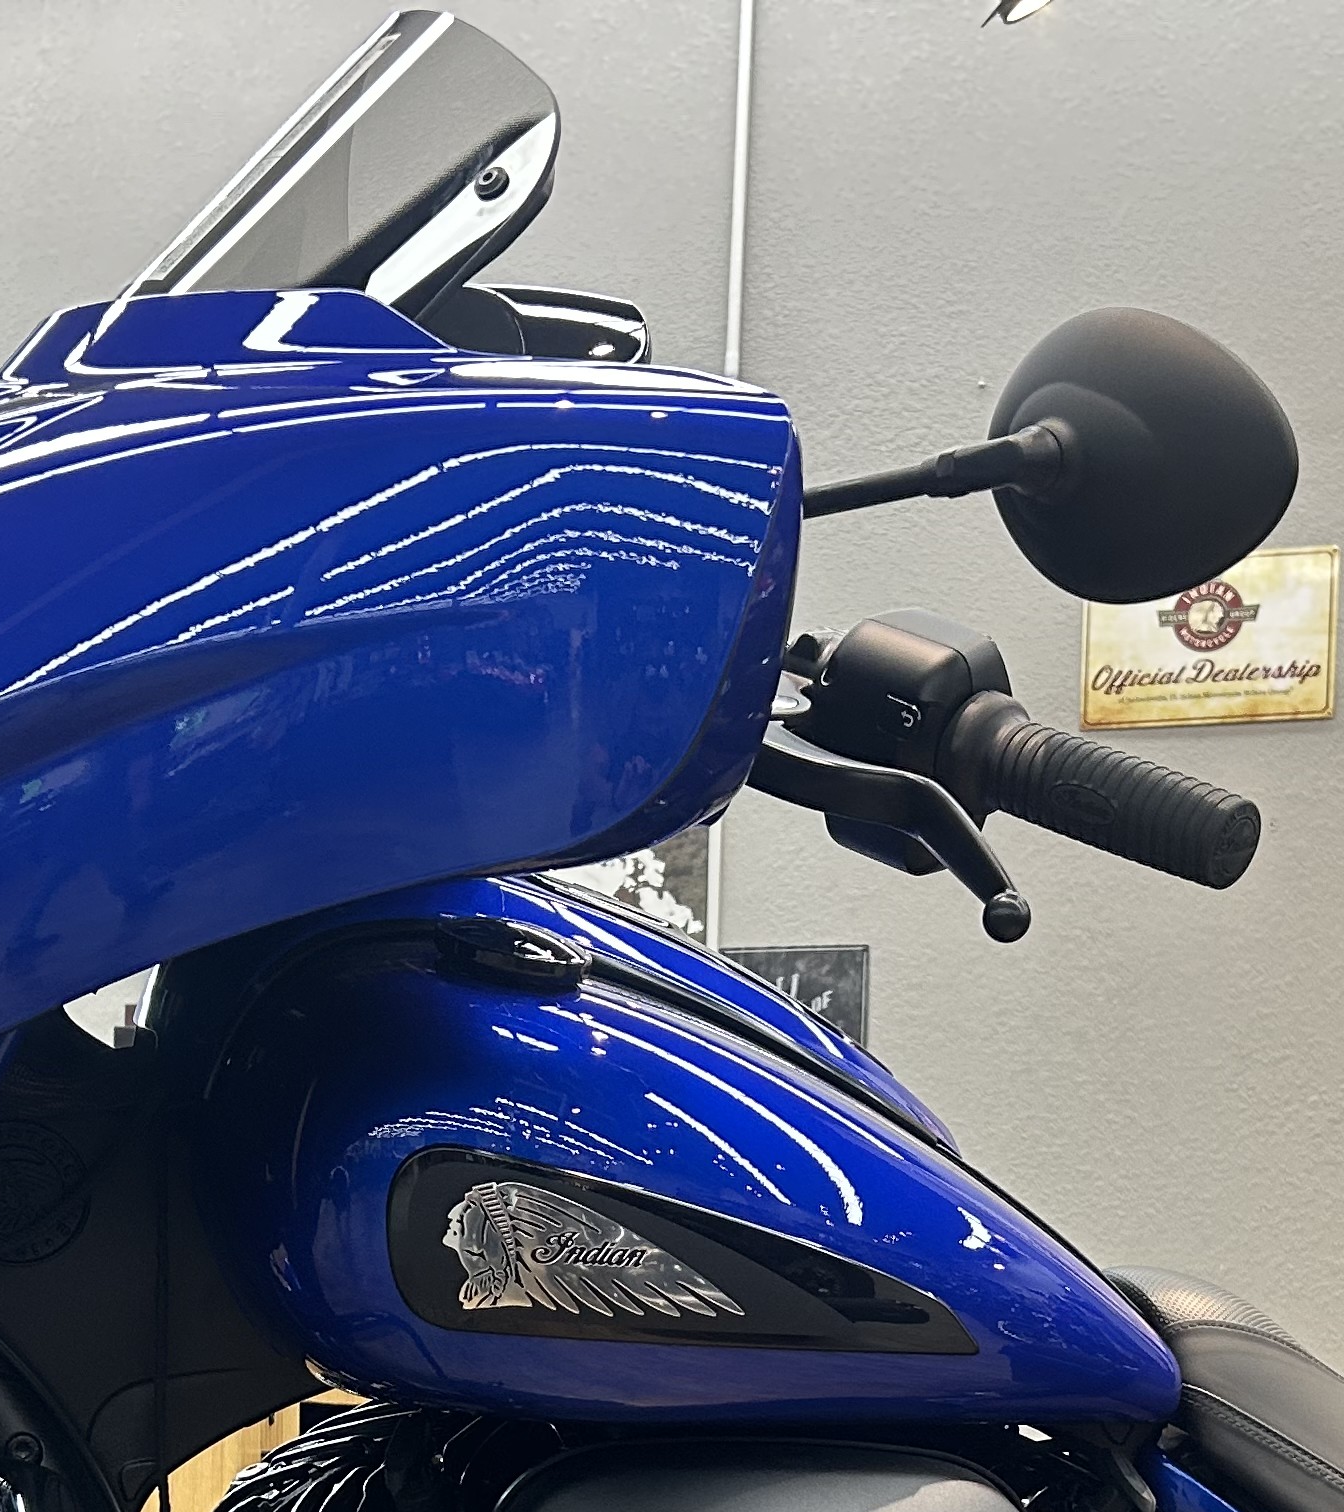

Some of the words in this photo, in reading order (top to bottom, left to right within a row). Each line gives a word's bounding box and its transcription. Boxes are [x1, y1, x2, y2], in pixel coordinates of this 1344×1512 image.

[1091, 664, 1187, 695] Official
[1185, 658, 1322, 685] Dealership
[531, 1231, 647, 1268] Indian
